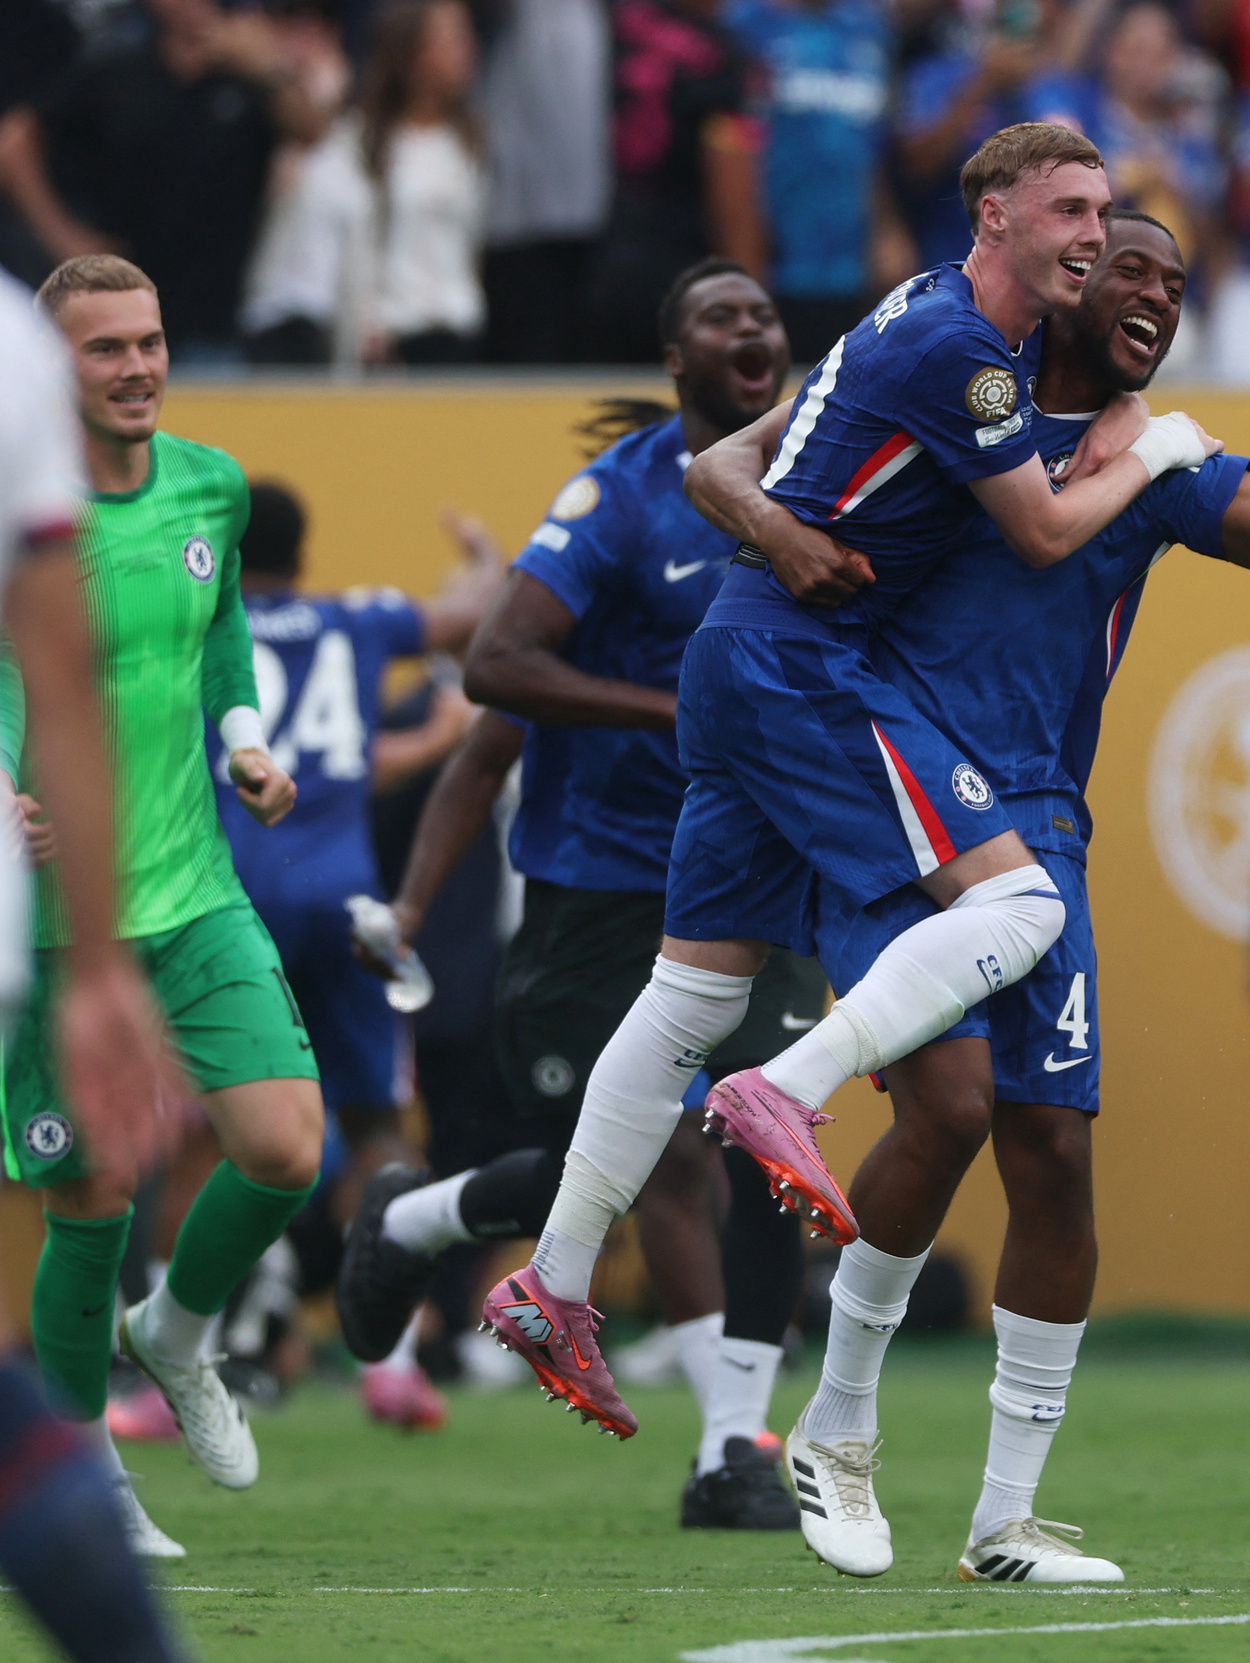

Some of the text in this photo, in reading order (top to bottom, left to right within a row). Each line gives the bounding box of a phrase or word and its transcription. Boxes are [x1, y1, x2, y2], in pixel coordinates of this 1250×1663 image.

[972, 371, 993, 393] WORLD
[994, 371, 1008, 379] CUP
[971, 396, 983, 412] CLUB
[986, 407, 1007, 418] FIFA
[1057, 972, 1089, 1049] 4
